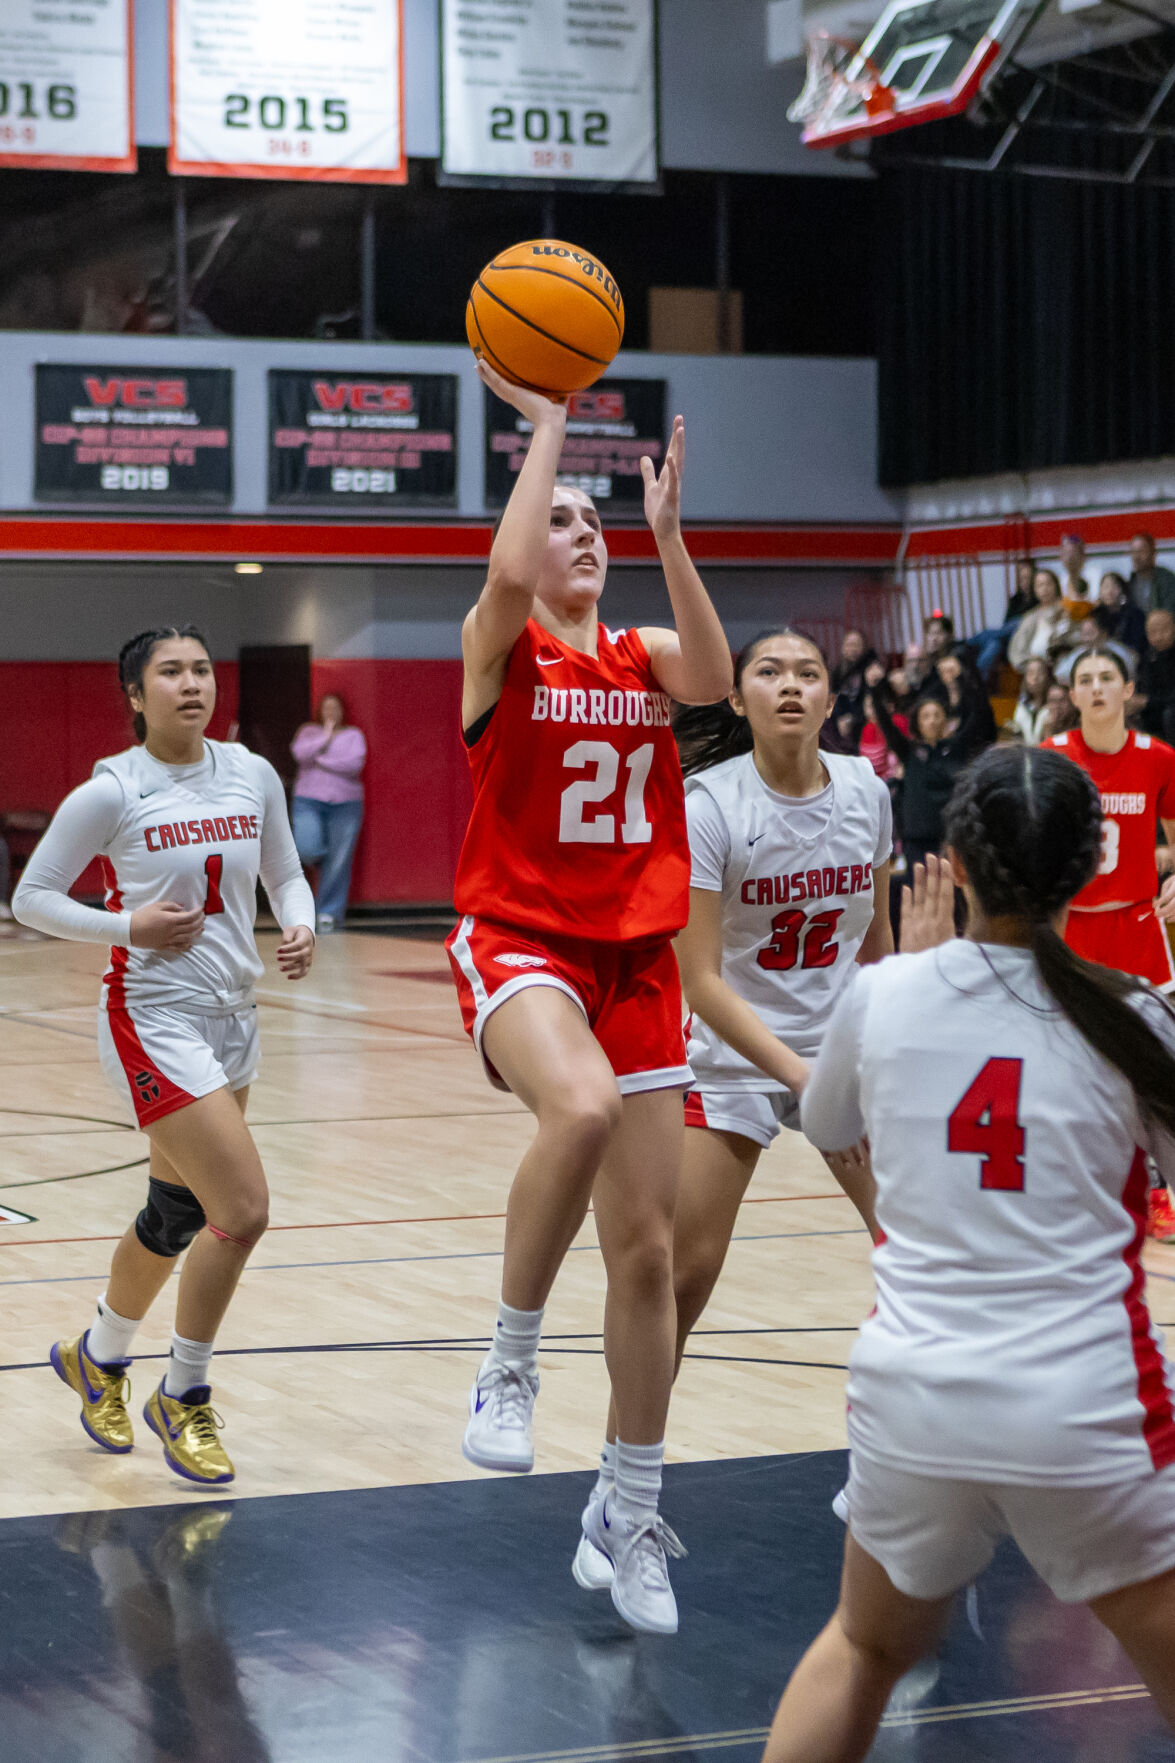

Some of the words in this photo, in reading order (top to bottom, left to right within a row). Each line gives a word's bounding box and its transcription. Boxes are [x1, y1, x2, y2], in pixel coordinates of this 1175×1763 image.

[224, 93, 349, 132] 2015
[490, 106, 610, 145] 2012
[532, 246, 621, 312] Wilson
[84, 377, 187, 407] VCS
[313, 381, 413, 412] VCS
[567, 391, 625, 420] CS
[102, 466, 169, 490] 2019
[332, 468, 396, 493] 2021
[531, 685, 671, 727] BURROUGHS
[558, 740, 655, 844] 21
[1100, 792, 1146, 815] OUGHS
[144, 815, 258, 852] CRUSADERS
[204, 854, 225, 915] 1
[741, 862, 873, 906] CRUSADERS
[756, 908, 846, 971] 32
[946, 1056, 1027, 1192] 4
